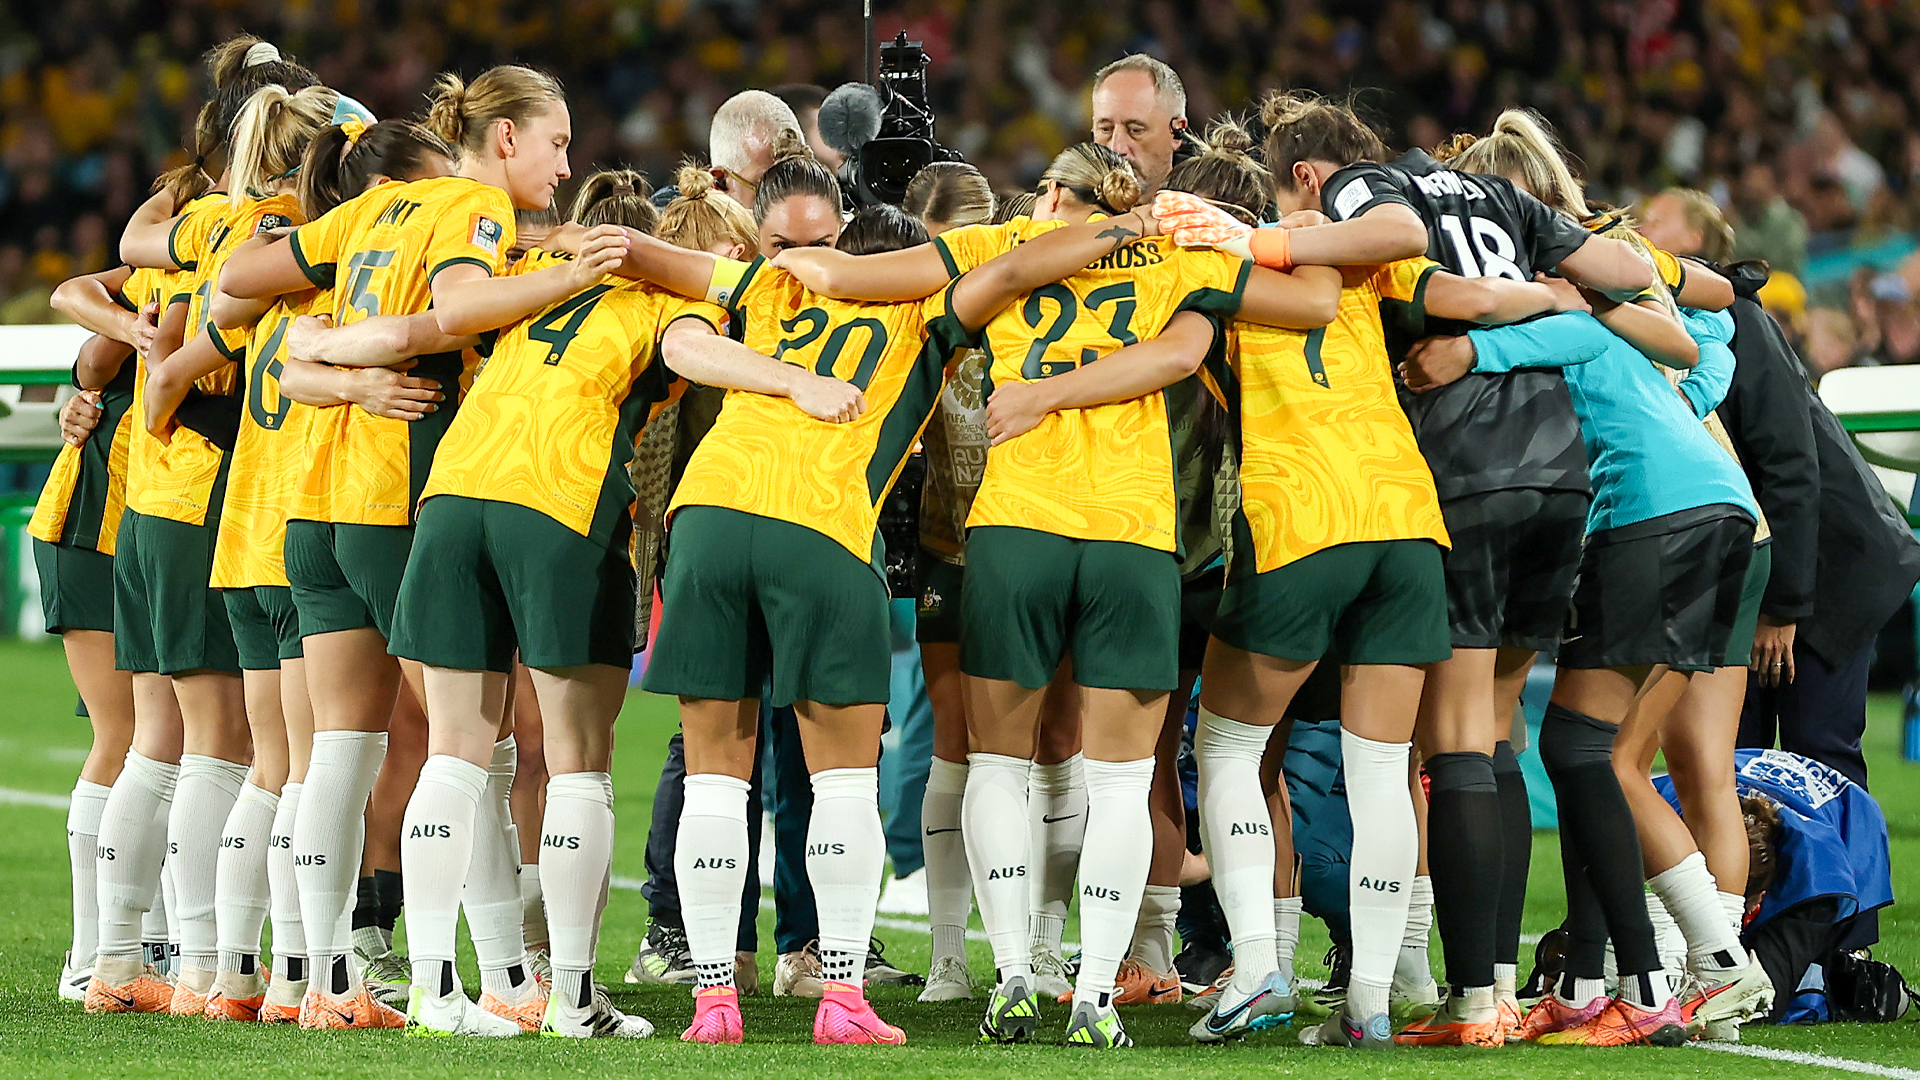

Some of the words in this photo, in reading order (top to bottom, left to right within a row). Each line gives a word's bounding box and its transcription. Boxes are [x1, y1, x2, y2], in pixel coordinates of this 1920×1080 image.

[1440, 214, 1527, 282] 18
[528, 285, 616, 367] 4
[1021, 282, 1139, 380] 23
[771, 307, 888, 393] 20
[249, 316, 292, 430] 6
[953, 448, 984, 465] AU
[956, 465, 985, 482] NZ
[410, 824, 451, 839] AUS
[1230, 822, 1269, 836] AUS
[542, 833, 581, 850] AUS
[98, 846, 116, 861] US
[807, 843, 846, 858] AUS
[295, 854, 327, 866] AUS
[693, 857, 737, 869] AUS
[988, 865, 1026, 881] AUS
[1359, 876, 1401, 893] AUS
[1083, 885, 1121, 902] AUS
